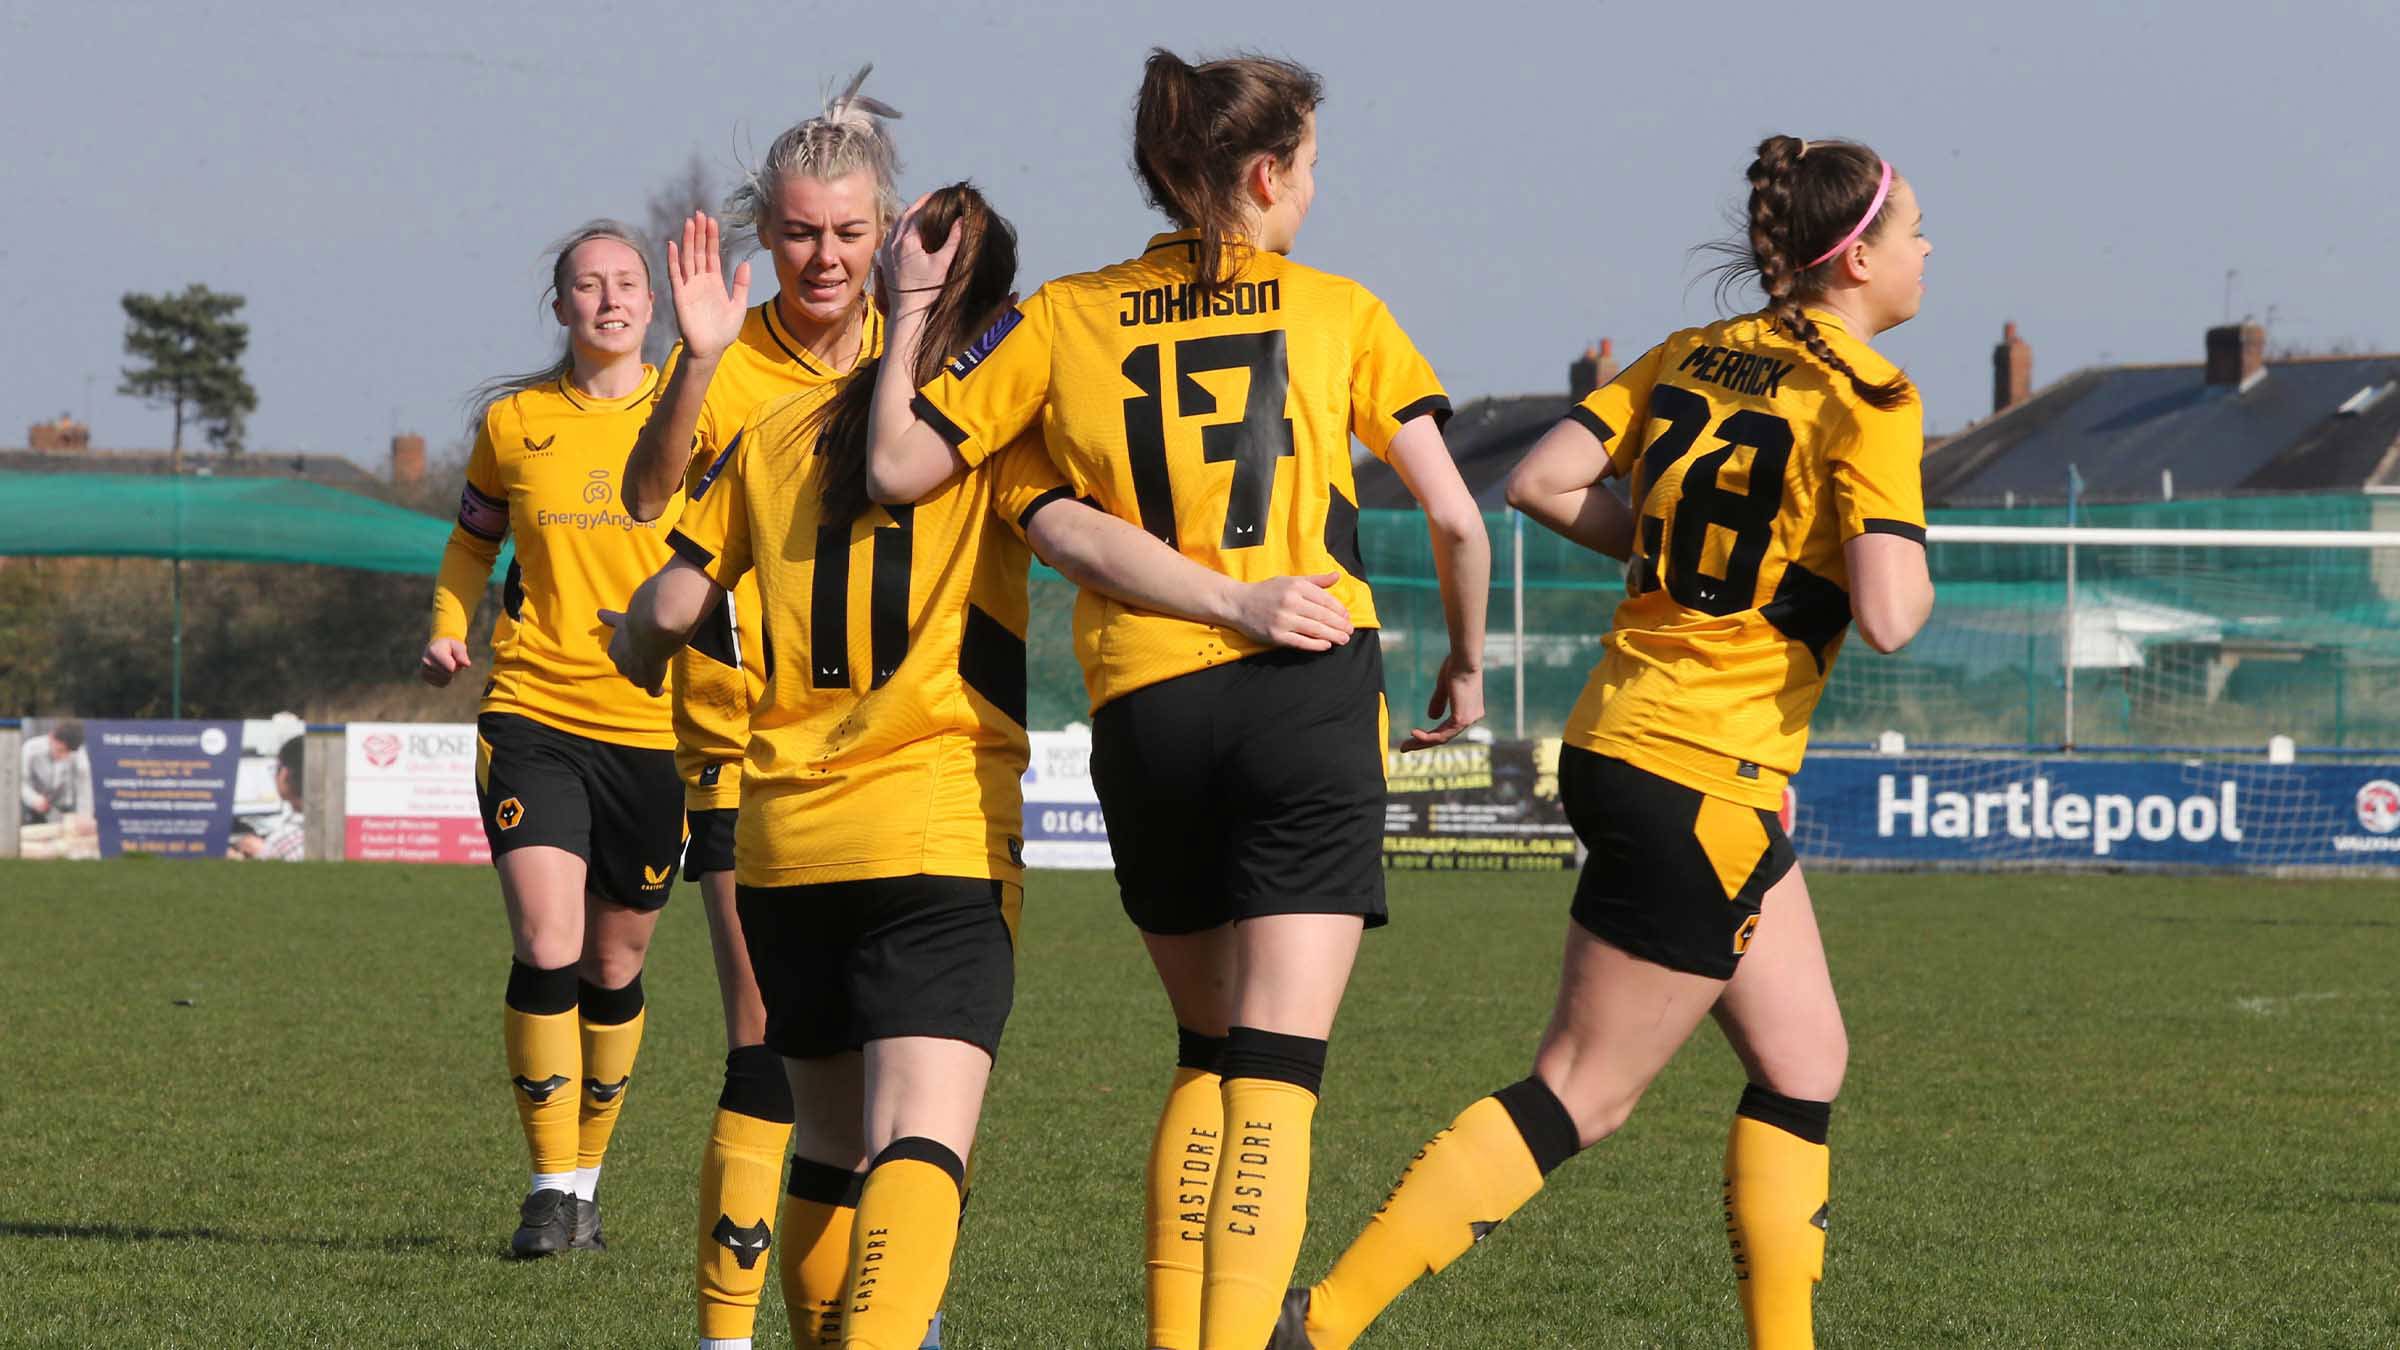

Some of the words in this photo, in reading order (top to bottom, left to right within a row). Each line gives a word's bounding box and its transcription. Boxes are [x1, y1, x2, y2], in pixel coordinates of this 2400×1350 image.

[1120, 278, 1281, 327] JOHNSON
[1676, 344, 1796, 398] MERRICK
[1121, 330, 1295, 550] 17
[536, 510, 657, 531] EnergyAngs
[1640, 383, 1796, 618] 28
[811, 420, 915, 690] 11
[408, 733, 469, 758] ROSE
[1877, 774, 2244, 855] Hartlepool
[1179, 1127, 1217, 1242] CASTORE
[1226, 1121, 1273, 1236] CASTORE
[853, 1228, 888, 1313] CASTORE
[820, 1299, 841, 1346] TORE
